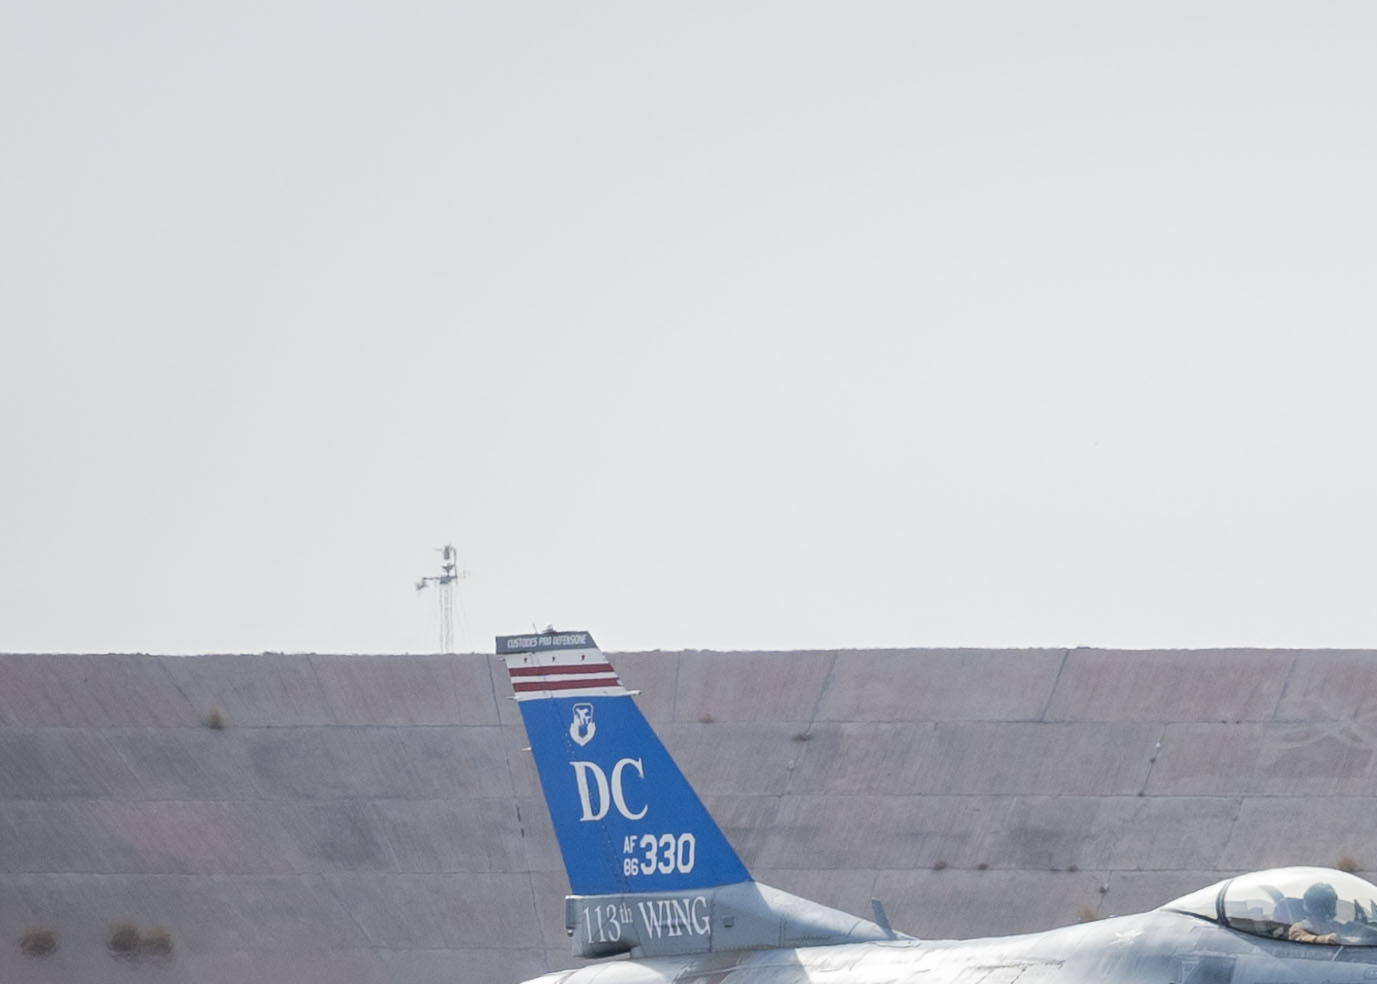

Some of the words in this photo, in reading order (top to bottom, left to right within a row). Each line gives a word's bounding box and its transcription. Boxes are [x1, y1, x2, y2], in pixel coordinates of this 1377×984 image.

[538, 636, 552, 646] PRO
[569, 757, 648, 822] DC
[623, 835, 638, 854] AF
[640, 833, 696, 875] 330
[623, 858, 638, 876] 86
[583, 902, 634, 944] 113th
[638, 896, 711, 940] WING
